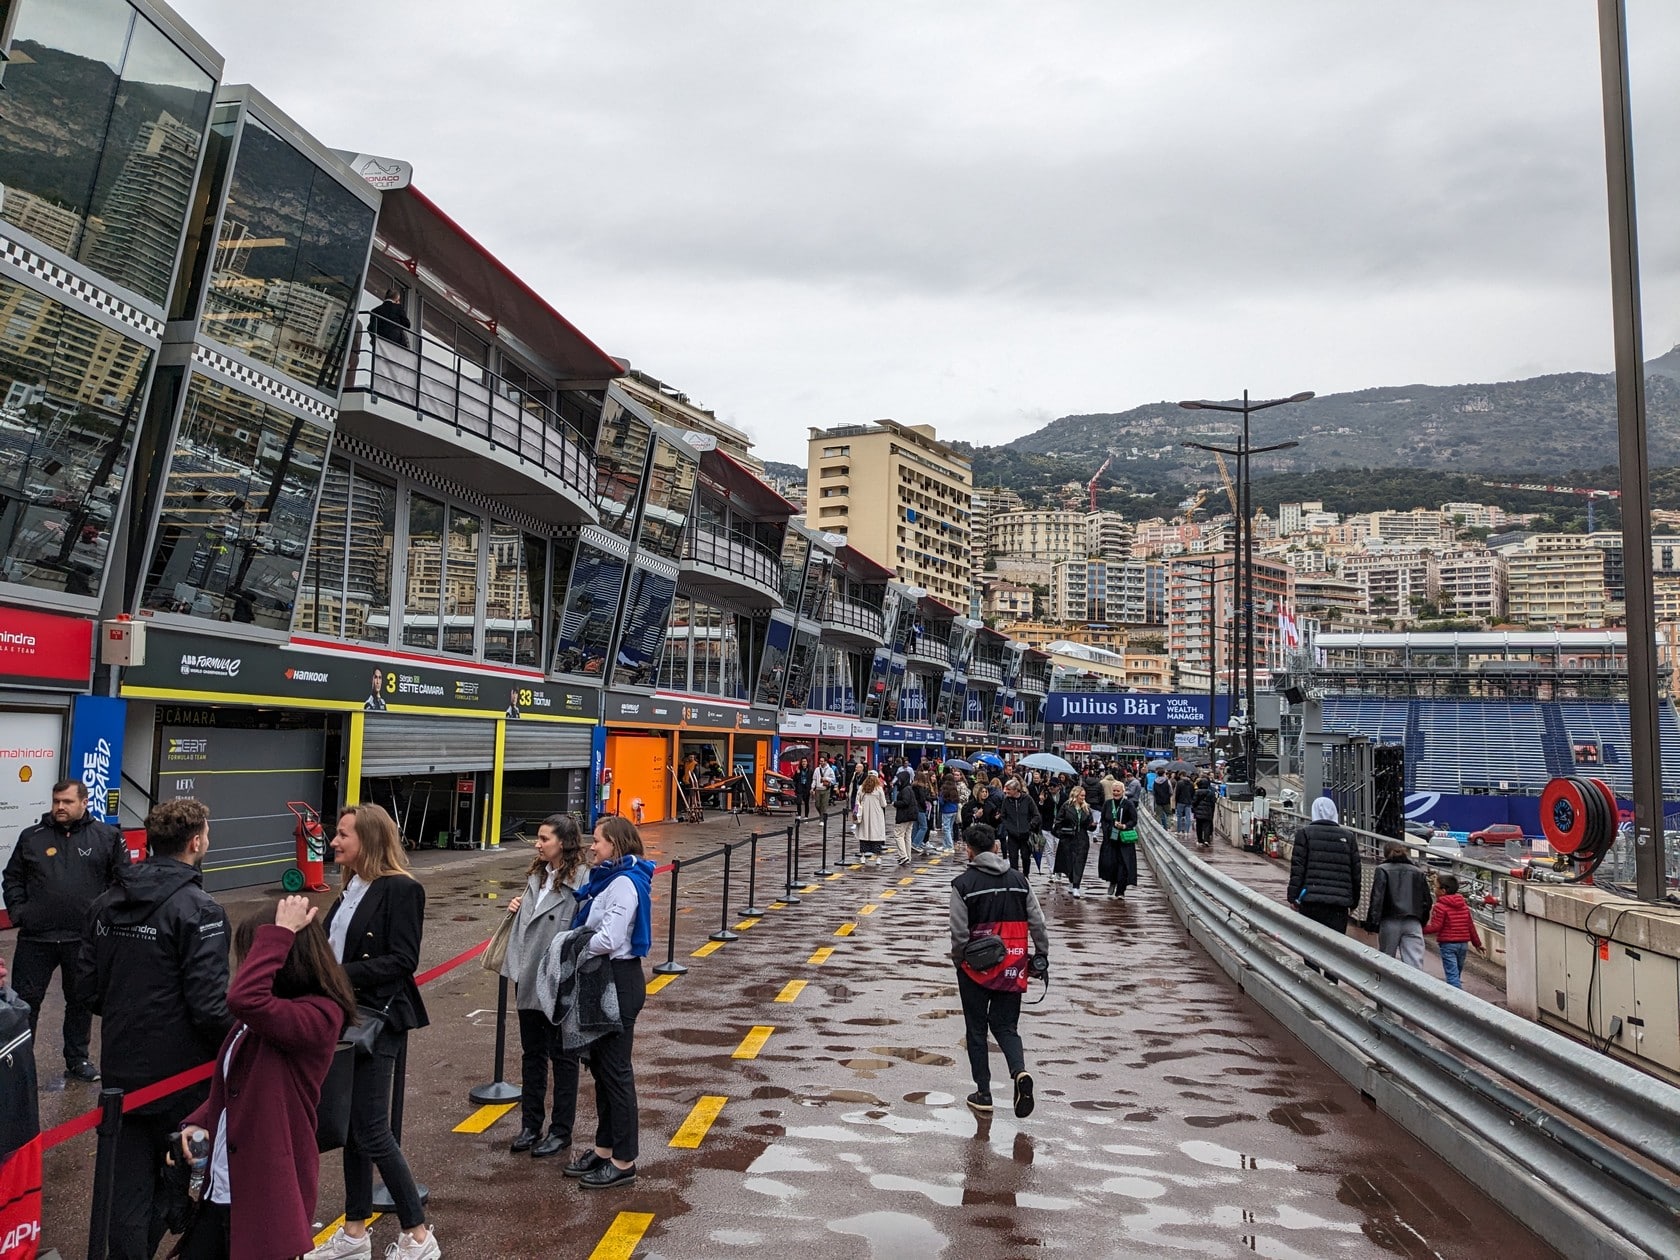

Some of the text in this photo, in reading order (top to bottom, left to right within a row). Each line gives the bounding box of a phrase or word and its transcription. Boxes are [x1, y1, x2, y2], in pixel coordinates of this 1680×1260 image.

[386, 672, 396, 693] 3
[399, 683, 445, 696] SETTE CÂMARA
[519, 689, 532, 706] 33
[1062, 697, 1160, 717] Julius Bär
[166, 707, 216, 725] CÂMARA
[1166, 713, 1204, 721] MANAGER
[0, 748, 54, 758] mahindra
[1004, 969, 1017, 977] FIA
